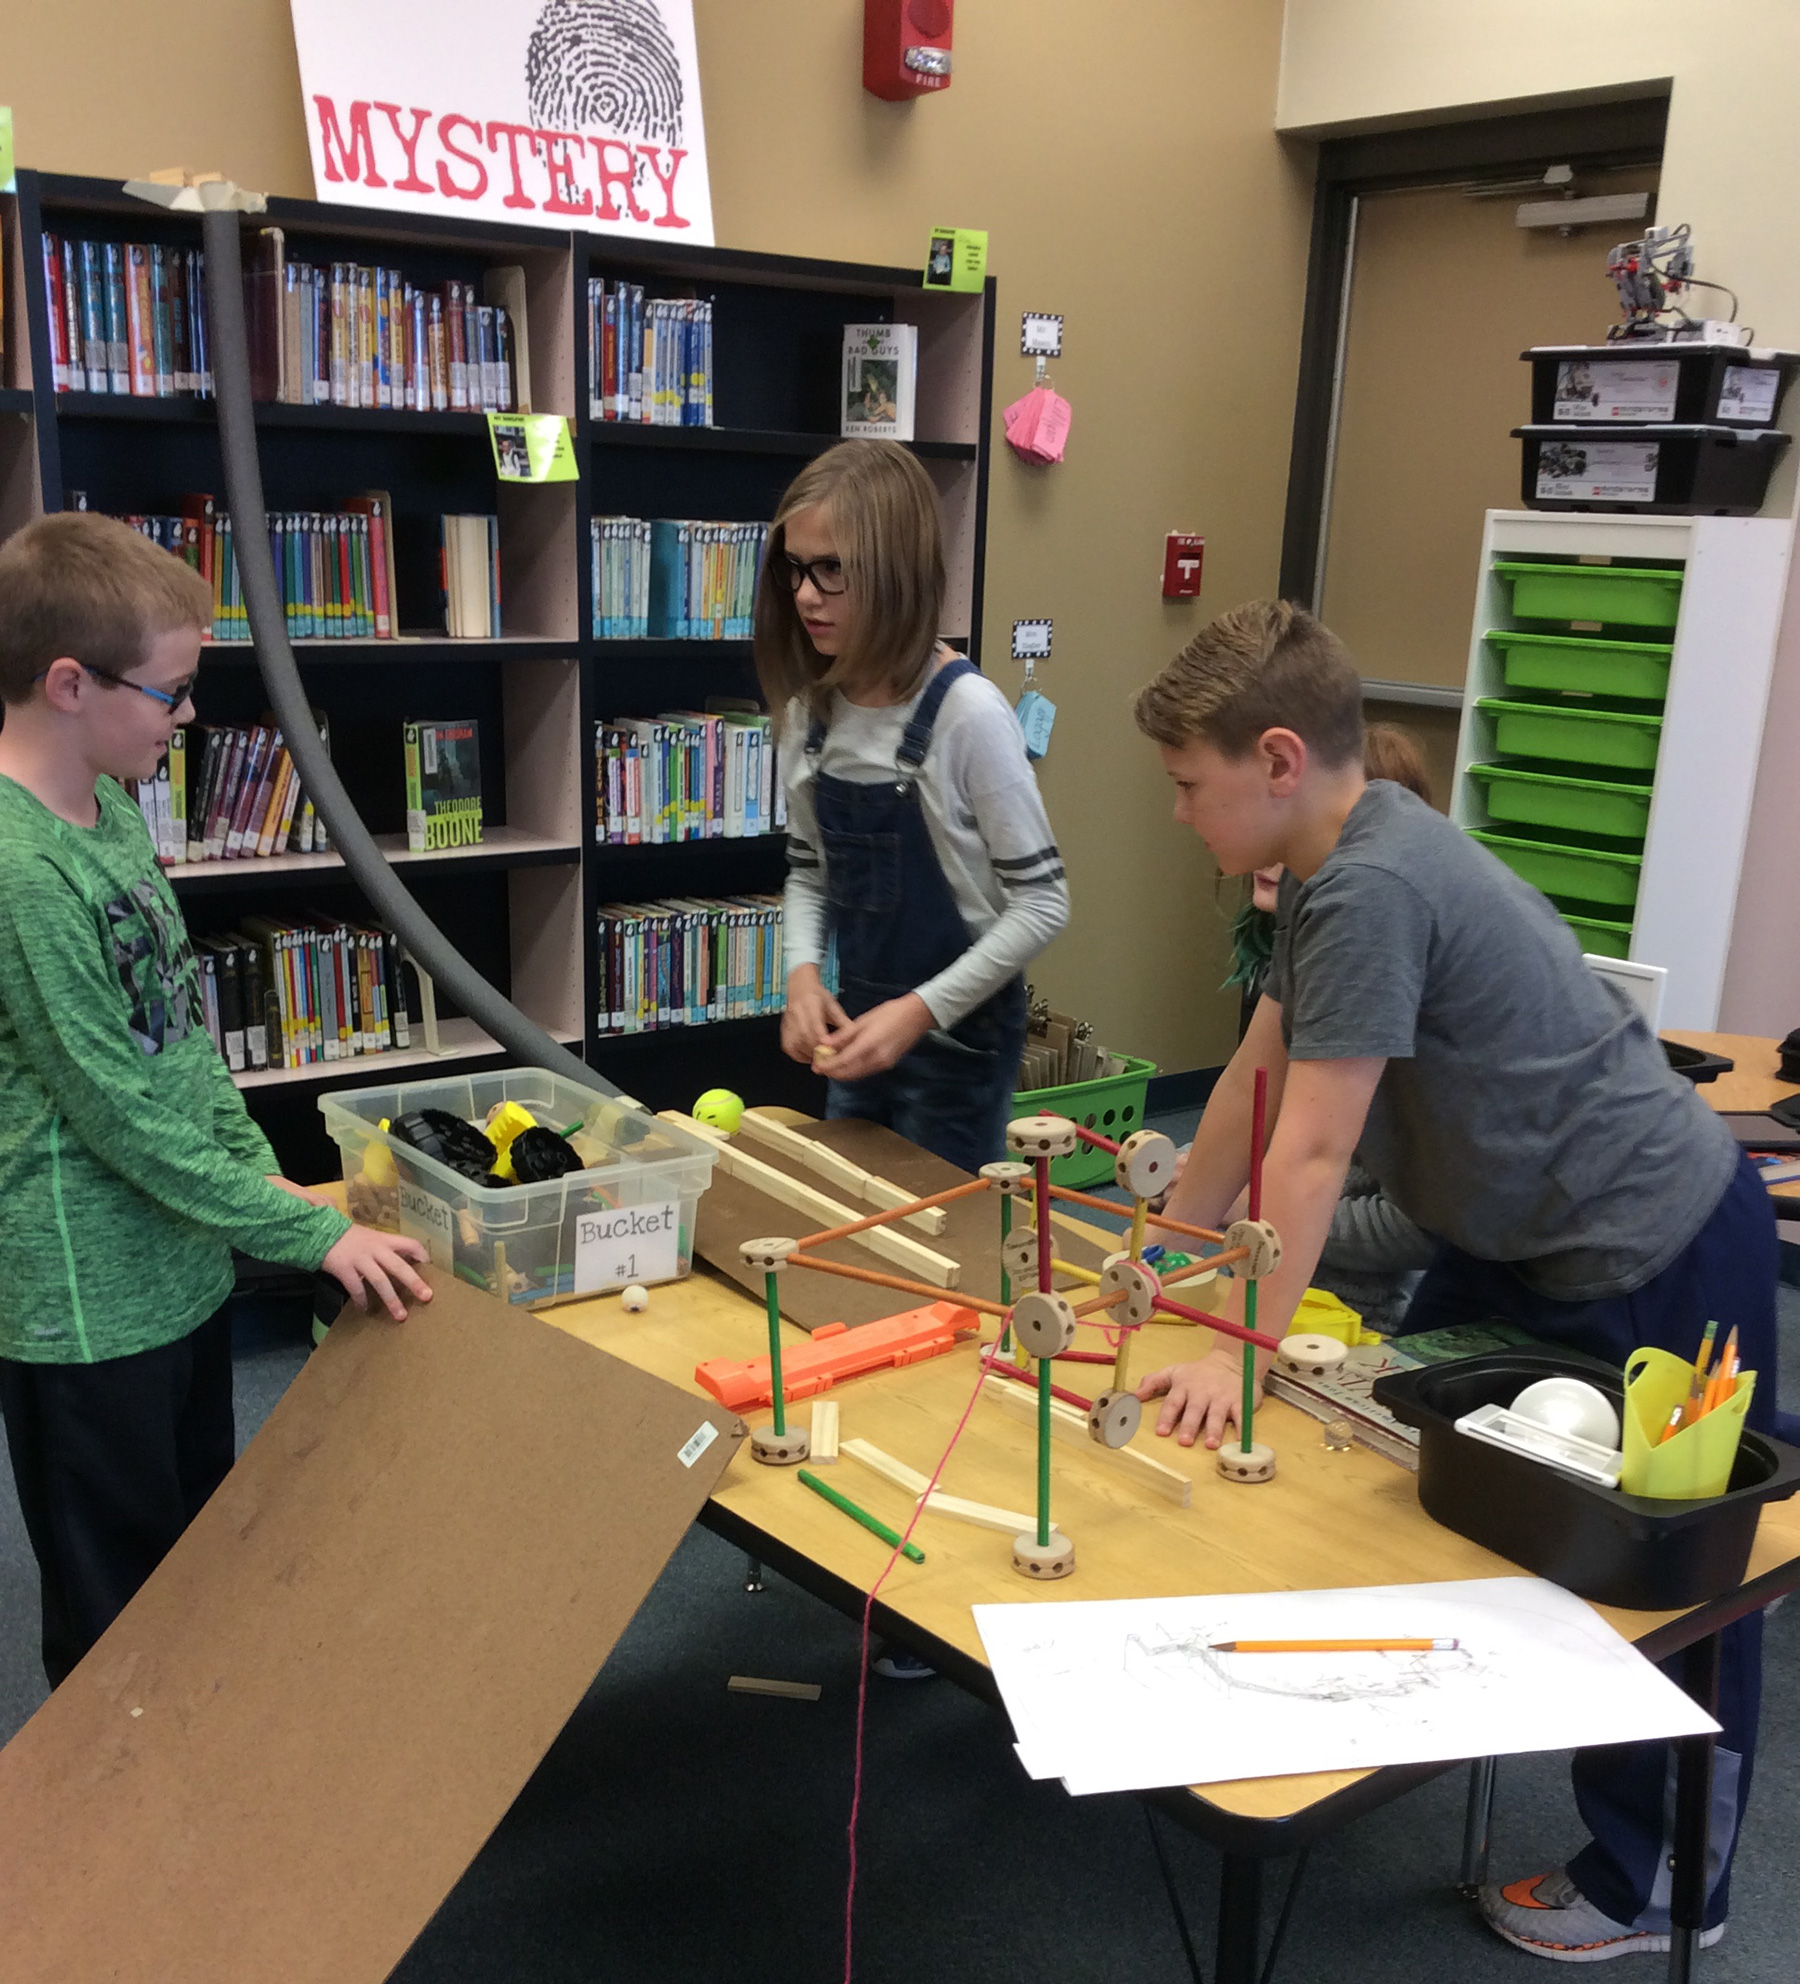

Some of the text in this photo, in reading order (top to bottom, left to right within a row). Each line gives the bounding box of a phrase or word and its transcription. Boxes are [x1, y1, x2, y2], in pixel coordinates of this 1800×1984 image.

[916, 73, 940, 88] FIRE
[312, 94, 691, 229] MYSTERY
[856, 328, 891, 338] THUMB
[848, 345, 899, 356] BAD GUYS
[863, 425, 897, 434] ROBERTS
[434, 796, 481, 815] THEODORE
[425, 817, 483, 851] BOONE
[399, 1185, 449, 1231] Bucket
[580, 1204, 673, 1244] Bucket
[615, 1253, 639, 1279] #1
